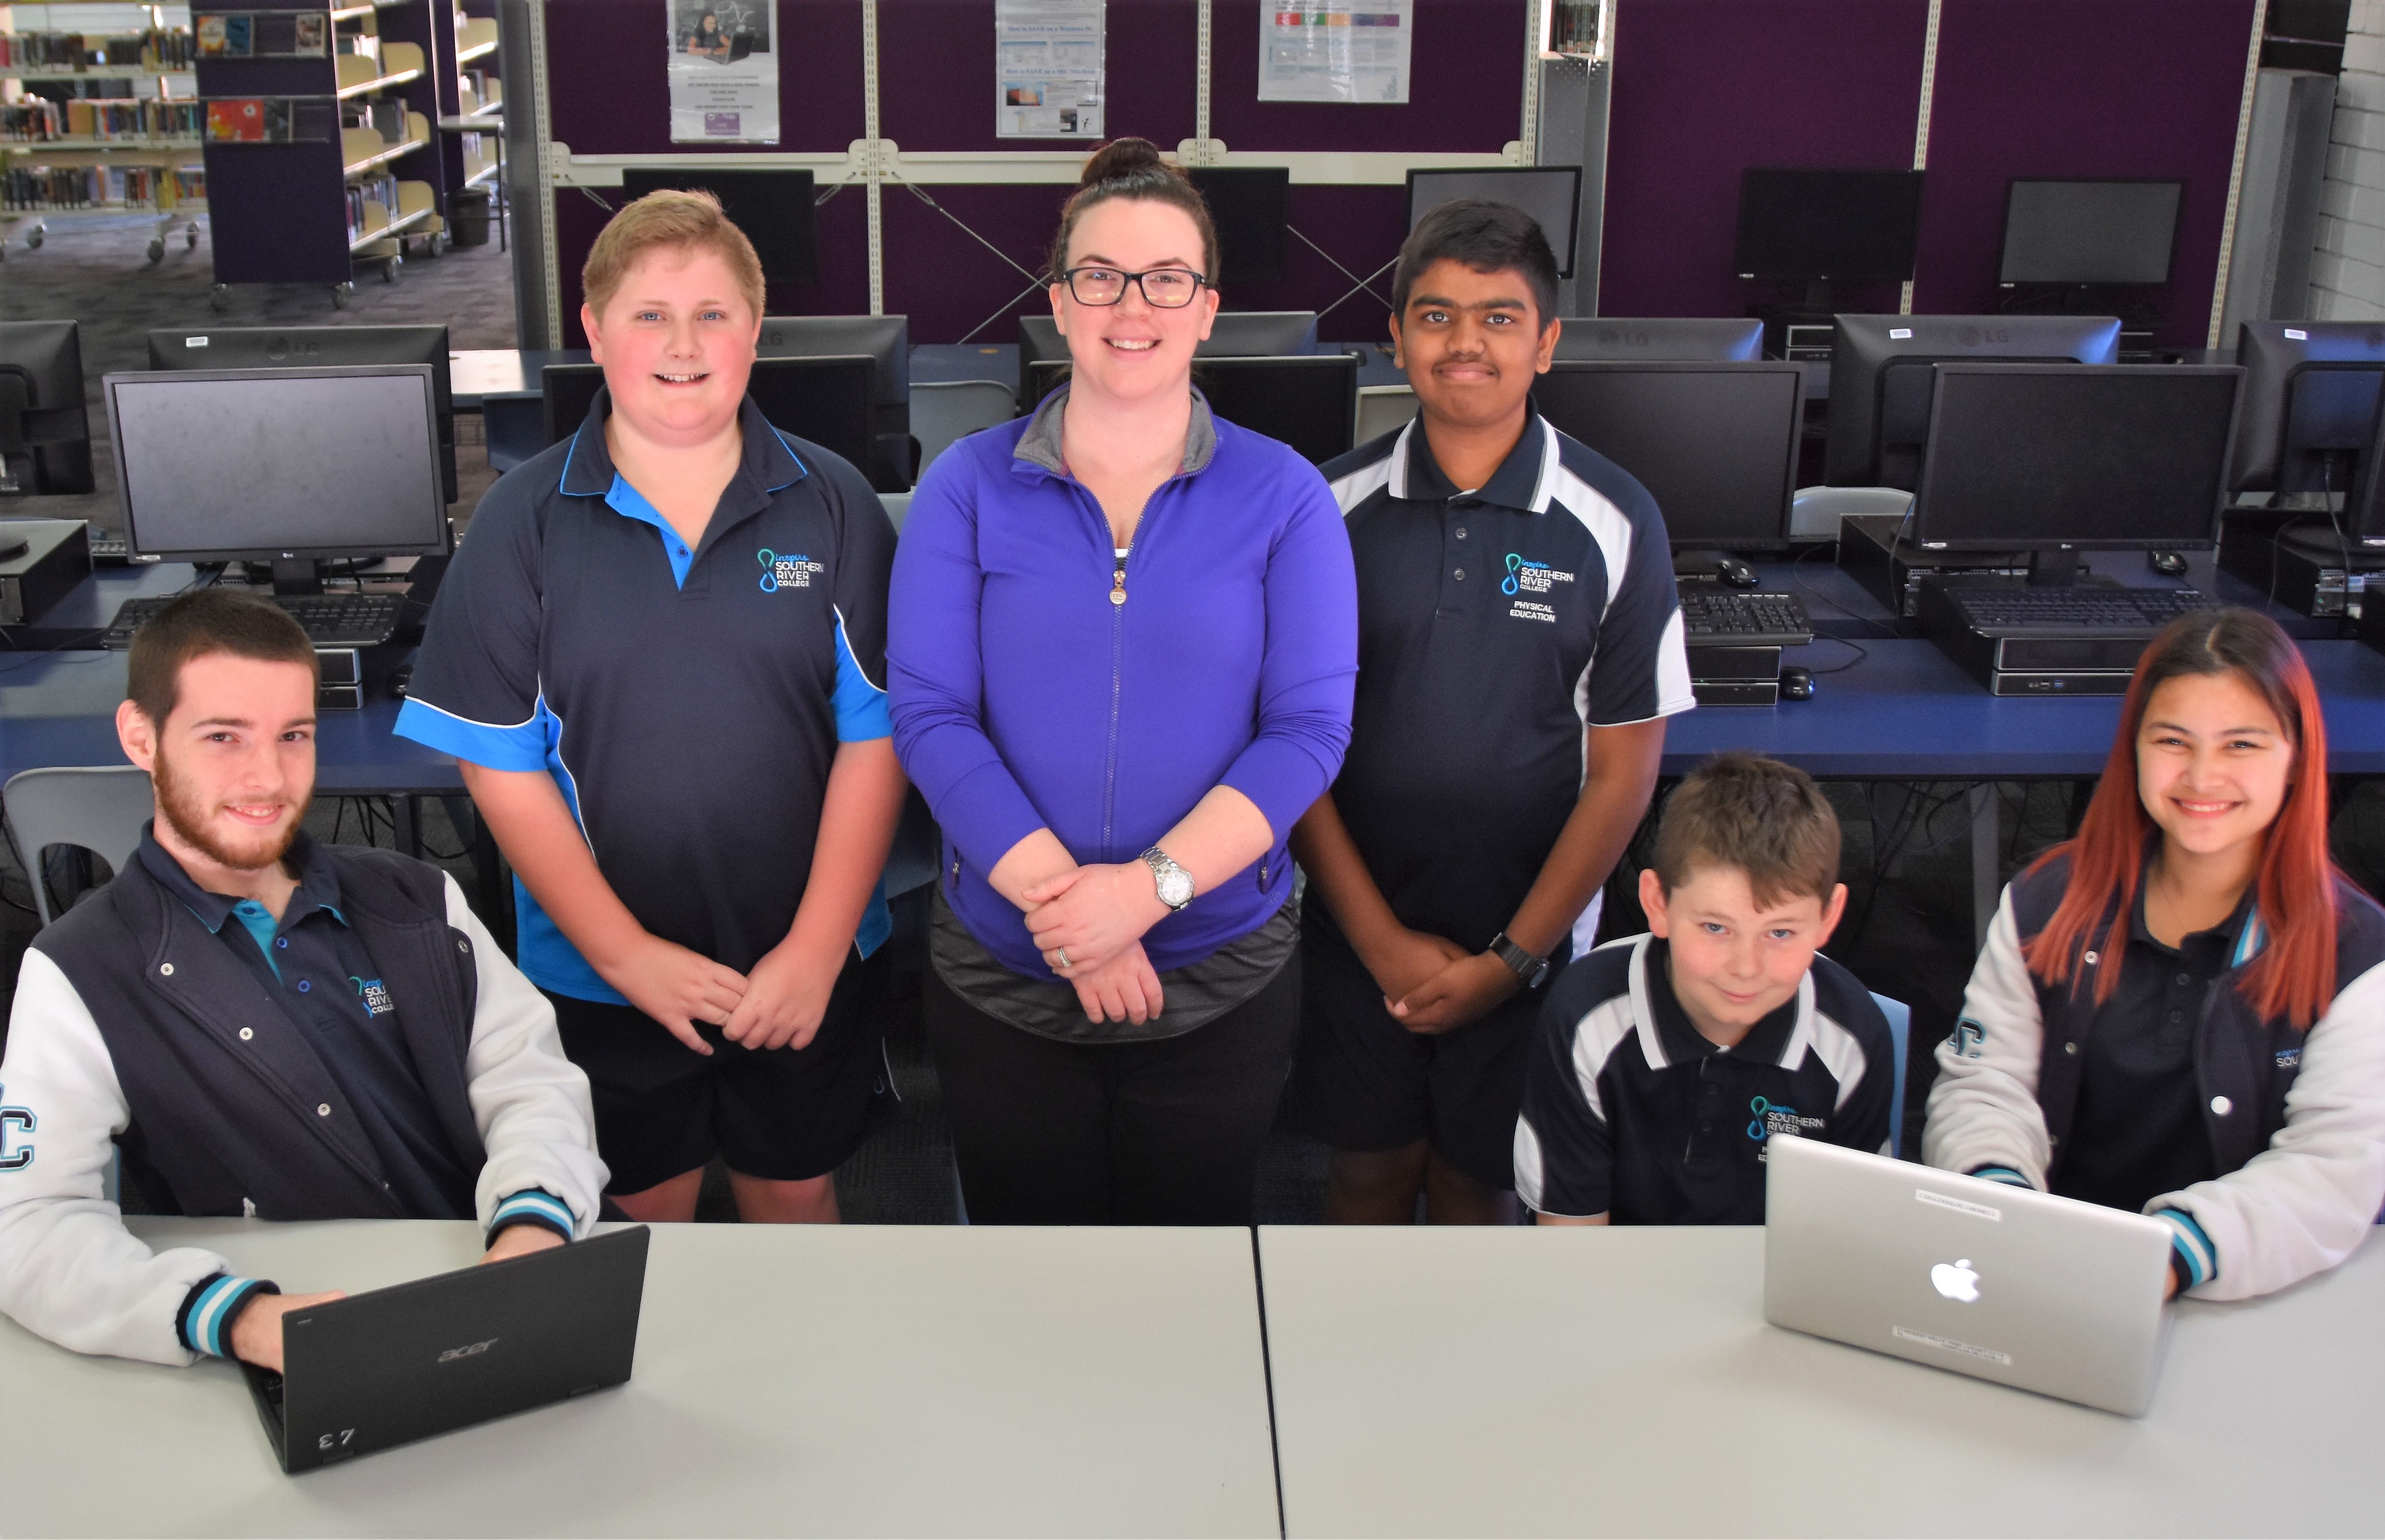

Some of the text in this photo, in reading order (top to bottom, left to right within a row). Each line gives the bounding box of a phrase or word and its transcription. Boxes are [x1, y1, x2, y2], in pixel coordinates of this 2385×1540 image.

[775, 561, 824, 573] SOUTHERN
[776, 571, 809, 581] RIVER
[1520, 567, 1575, 582] SOUTHERN
[1519, 584, 1548, 593] COLLEGE
[1520, 575, 1551, 589] RIVER
[1514, 600, 1554, 613] PHYSICAL
[1509, 609, 1556, 623] EDUCATION
[368, 994, 392, 1007] RIVE
[371, 1003, 395, 1013] COLLE
[1767, 1111, 1824, 1128] SOUTHERN
[1767, 1121, 1800, 1134] RIVER
[438, 1338, 498, 1362] acer
